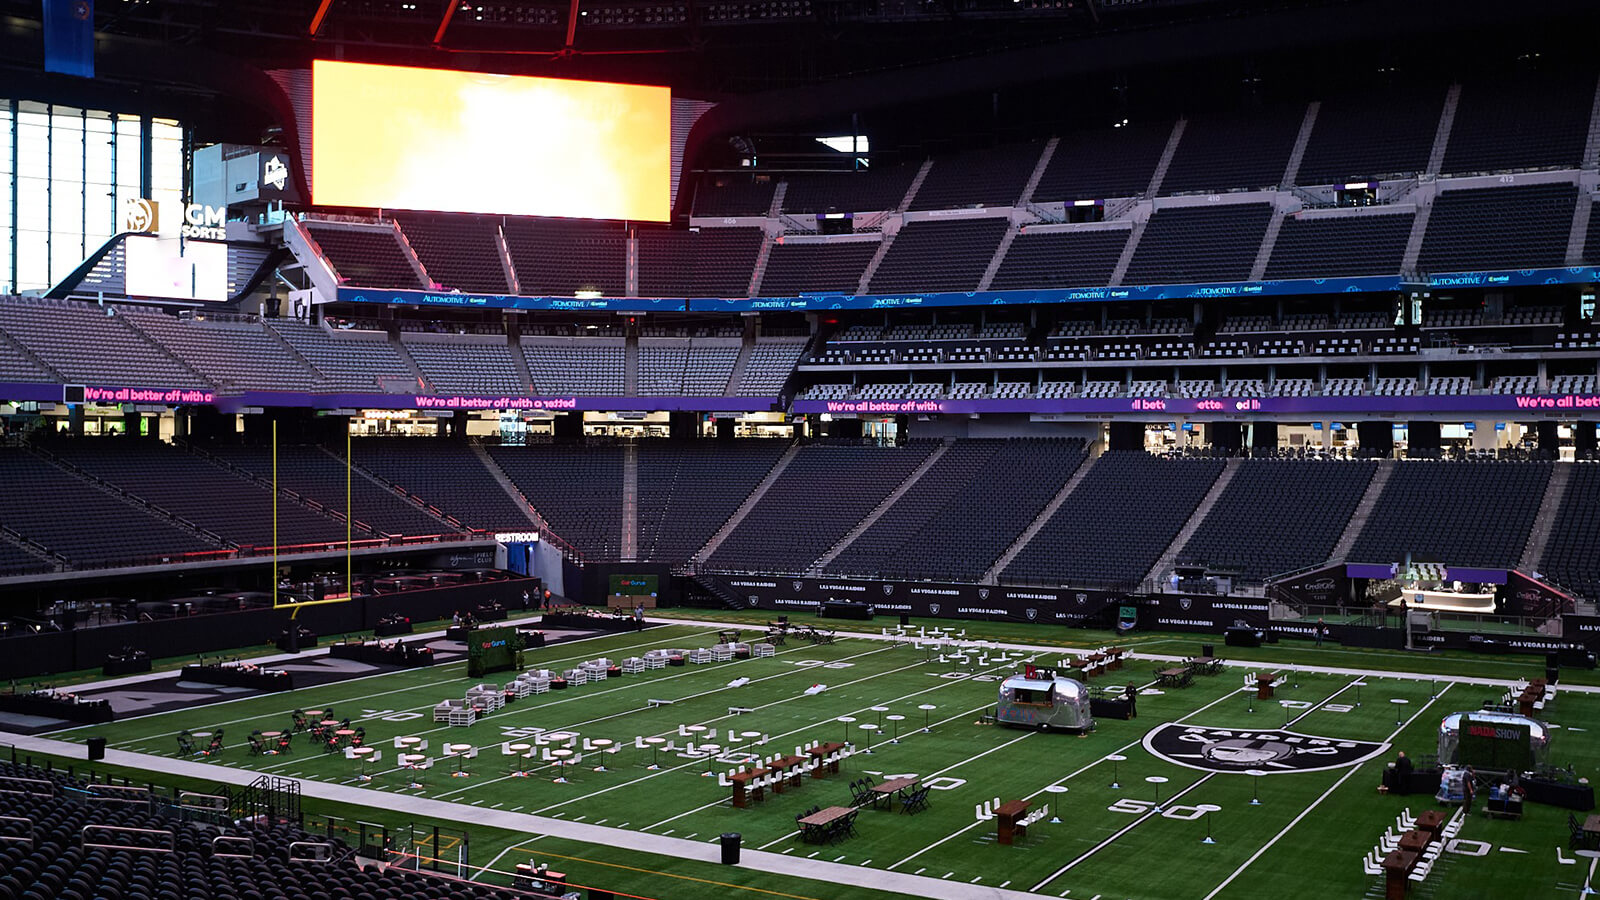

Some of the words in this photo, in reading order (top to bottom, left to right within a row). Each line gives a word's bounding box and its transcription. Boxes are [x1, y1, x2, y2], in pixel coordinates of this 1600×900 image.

[185, 203, 227, 228] GM
[181, 225, 227, 240] SORTS
[115, 388, 129, 400] all
[130, 389, 164, 401] better
[165, 390, 182, 401] off
[182, 390, 204, 402] with
[1516, 396, 1555, 408] We're
[1556, 395, 1573, 407] all
[416, 397, 446, 407] We're
[447, 397, 460, 407] all
[461, 397, 492, 407] better
[493, 397, 510, 407] off
[510, 397, 533, 408] with
[827, 402, 855, 411] We're
[856, 401, 868, 411] all
[869, 401, 900, 411] better
[900, 401, 916, 411] off
[916, 401, 938, 411] with
[1188, 619, 1213, 627] RAIDERS
[1184, 727, 1358, 749] RAIDERS
[1107, 798, 1208, 821] 50
